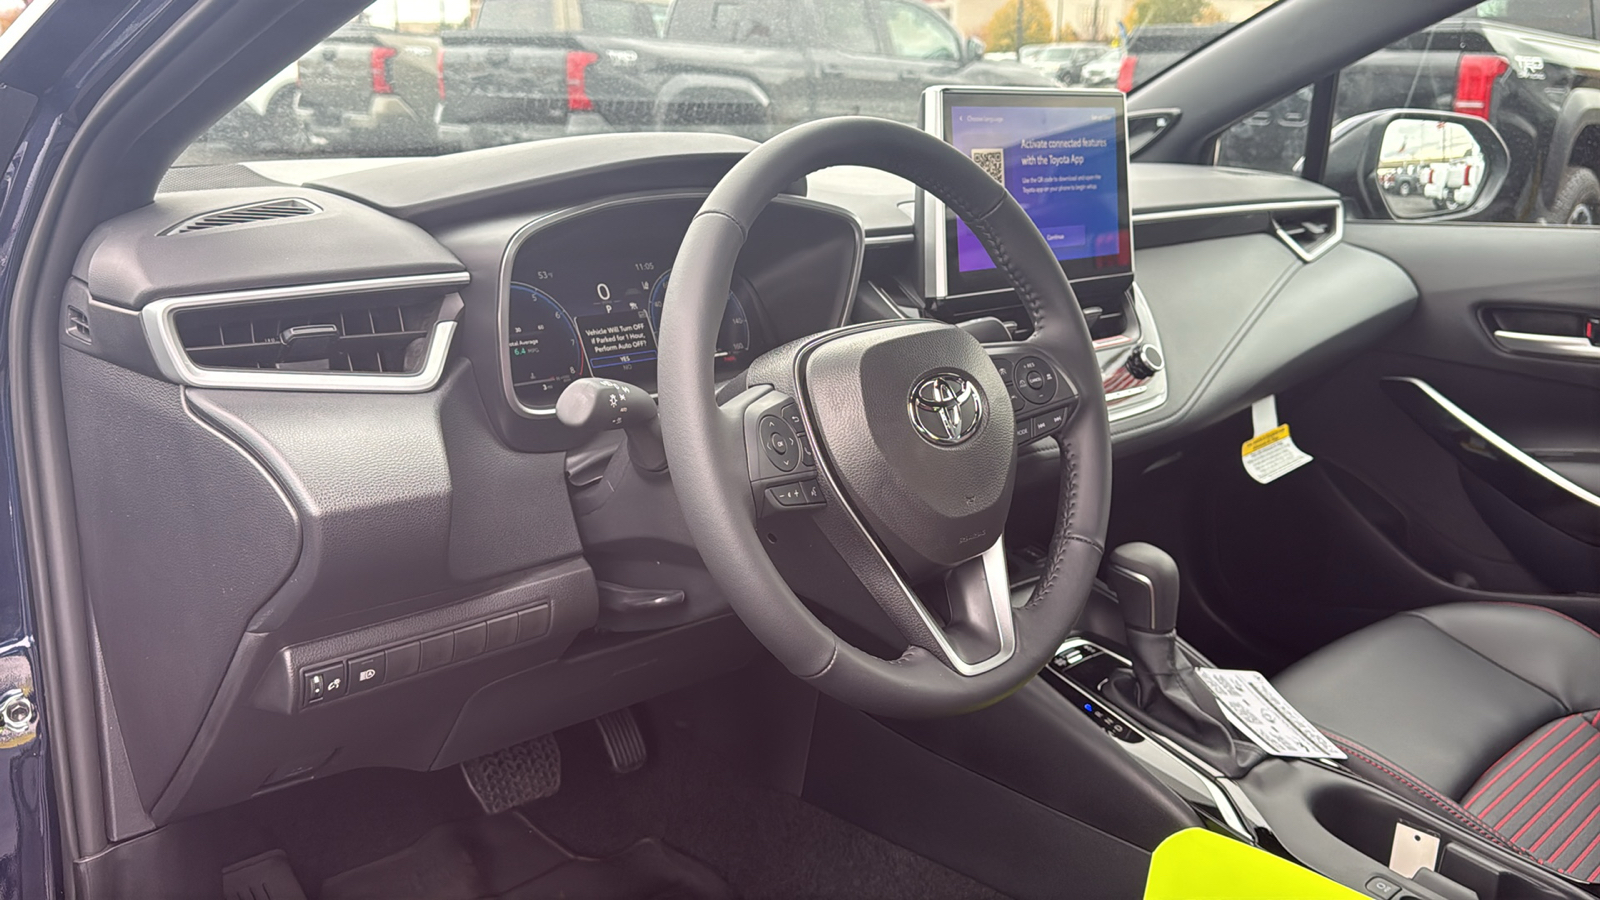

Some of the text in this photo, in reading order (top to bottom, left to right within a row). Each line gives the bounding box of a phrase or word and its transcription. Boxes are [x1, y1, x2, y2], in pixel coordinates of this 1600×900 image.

[1021, 138, 1107, 149] Activate connected features
[1022, 154, 1084, 166] with the Toyota App
[1022, 186, 1035, 195] Toyota
[1075, 184, 1086, 192] begin
[1046, 233, 1064, 241] Continue
[635, 262, 654, 271] 11:05
[597, 283, 610, 300] 0
[532, 294, 537, 302] 5
[605, 305, 612, 314] P
[555, 311, 560, 319] 6
[594, 345, 617, 353] Perform
